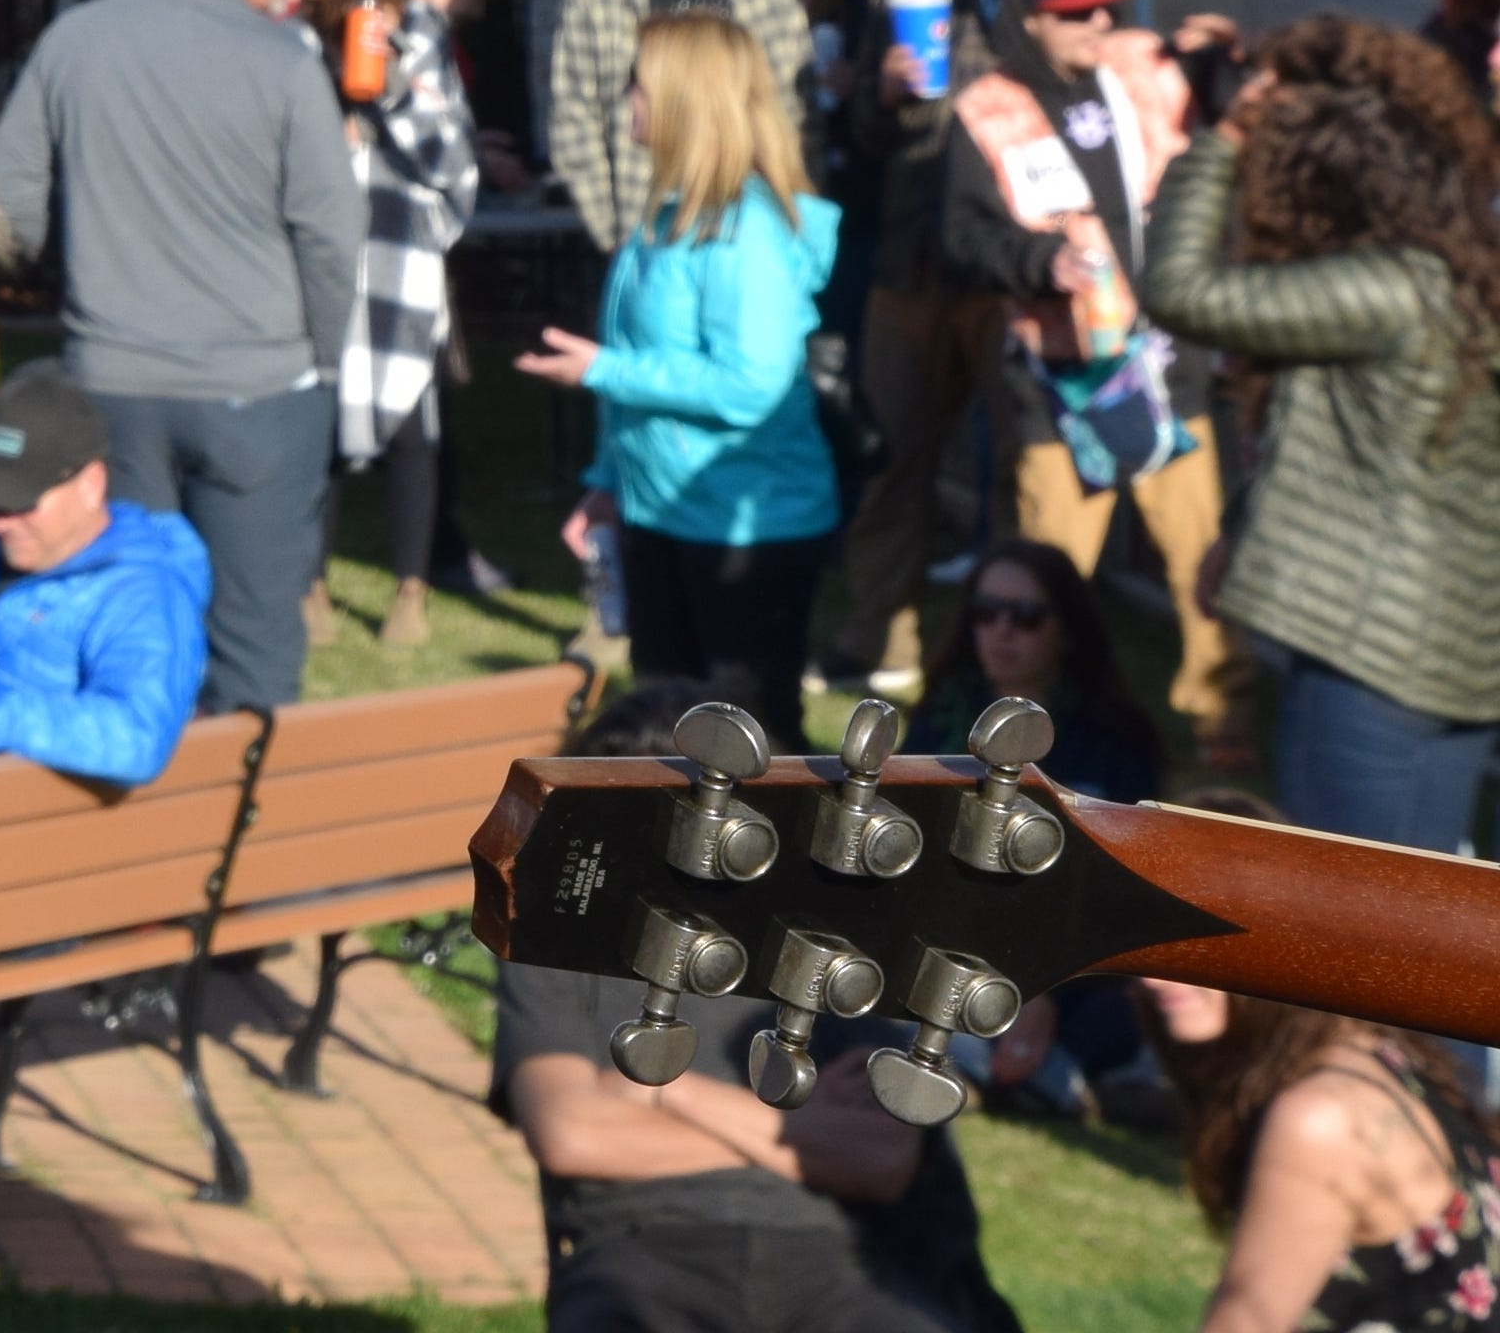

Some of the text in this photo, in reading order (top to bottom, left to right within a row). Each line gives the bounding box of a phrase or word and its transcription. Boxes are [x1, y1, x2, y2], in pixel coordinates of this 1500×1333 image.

[572, 858, 589, 896] MADE IN
[594, 869, 606, 888] USA
